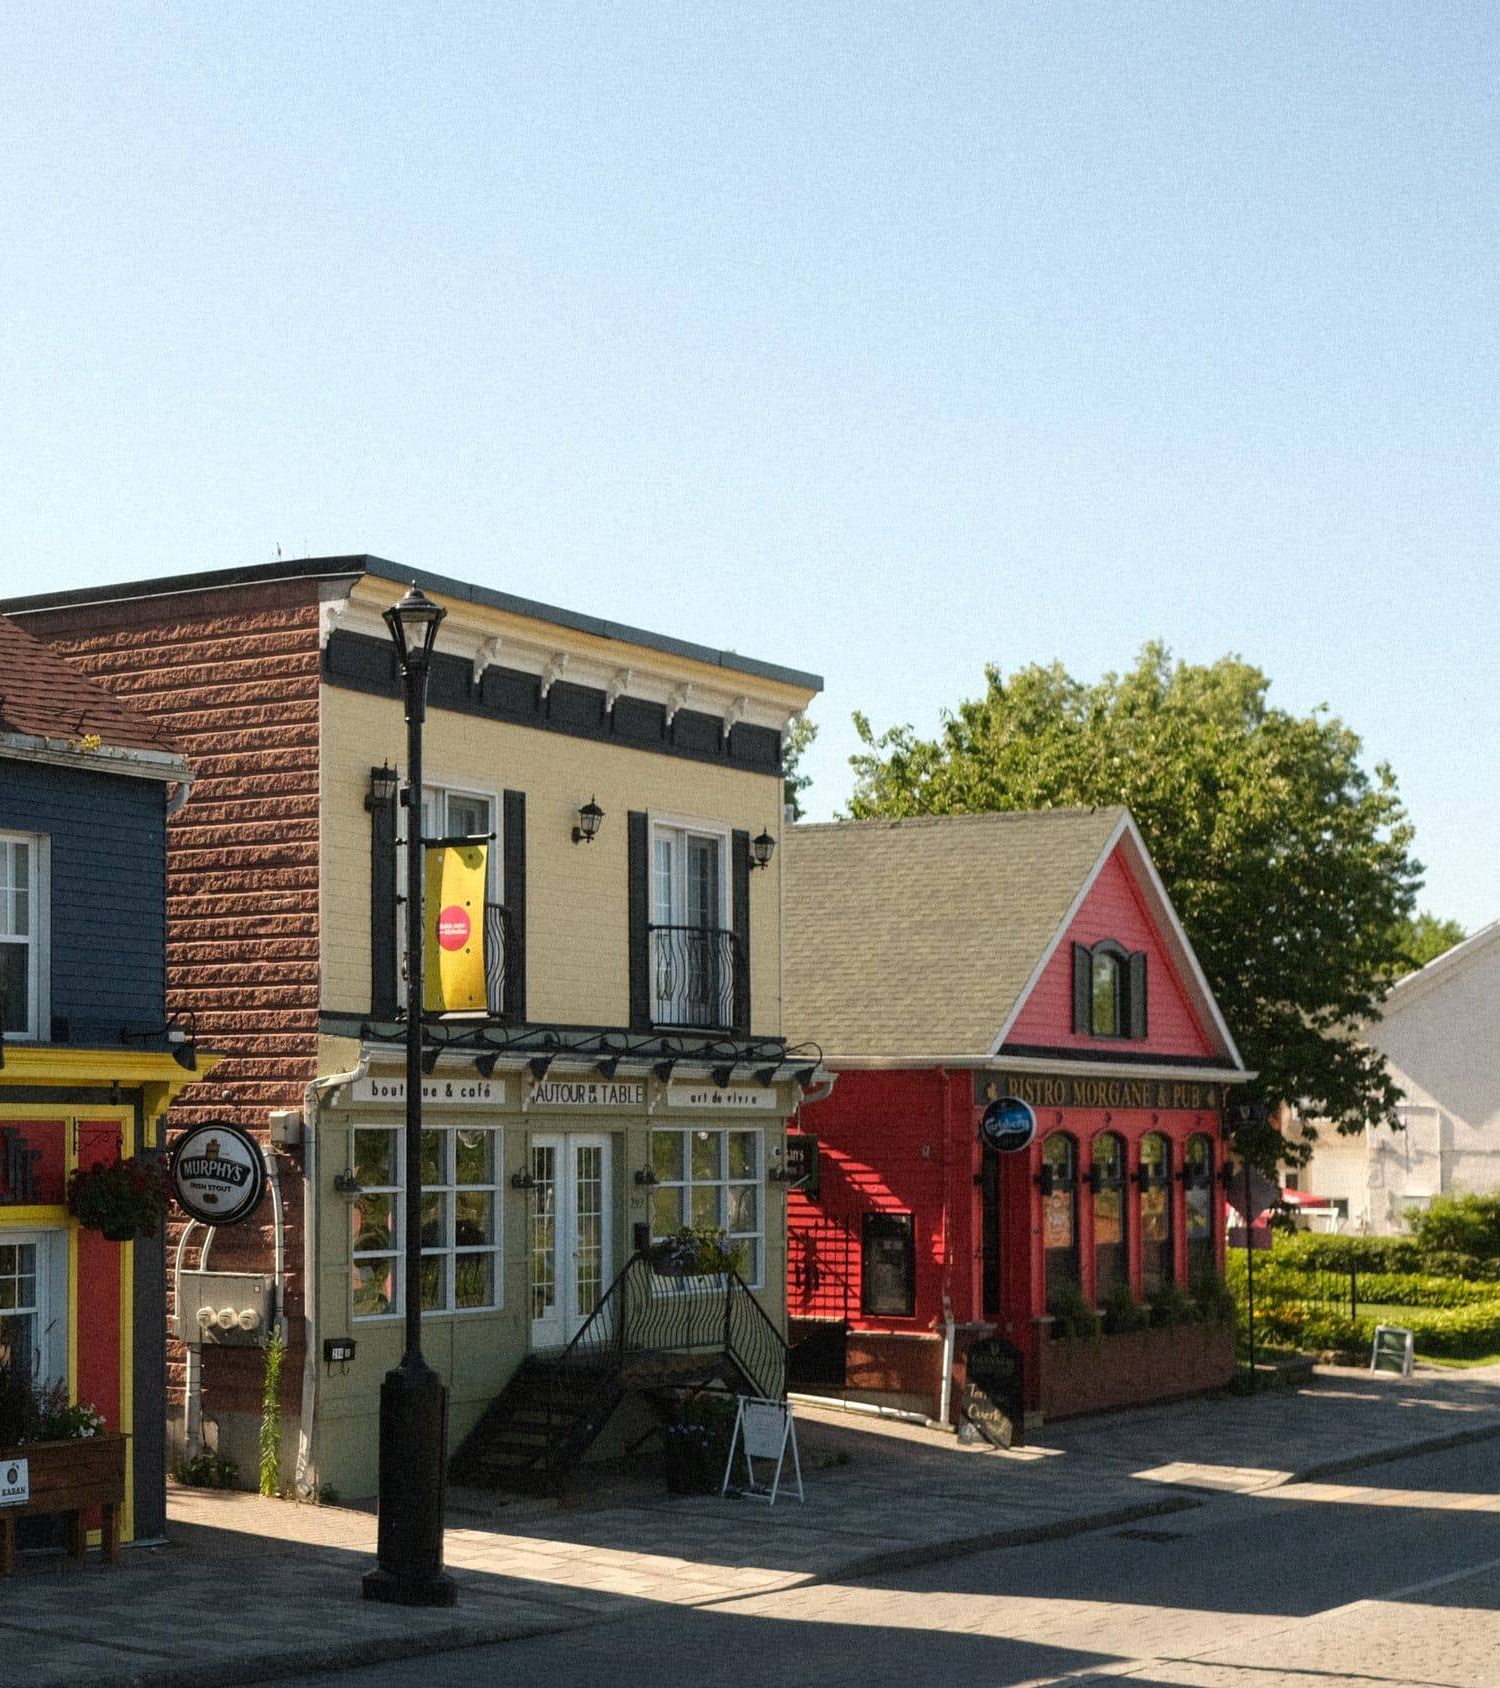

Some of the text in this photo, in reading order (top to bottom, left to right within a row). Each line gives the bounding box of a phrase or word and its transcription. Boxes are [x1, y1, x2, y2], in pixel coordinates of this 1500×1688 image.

[371, 1080, 491, 1097] boutue & café
[535, 1083, 586, 1103] AUTOUR
[602, 1085, 643, 1104] TABLE
[1008, 1078, 1066, 1104] BISTRO
[1073, 1081, 1153, 1107] MORGANE
[1173, 1085, 1200, 1108] PUB
[727, 1092, 757, 1104] vivre
[208, 1184, 232, 1193] STOUT
